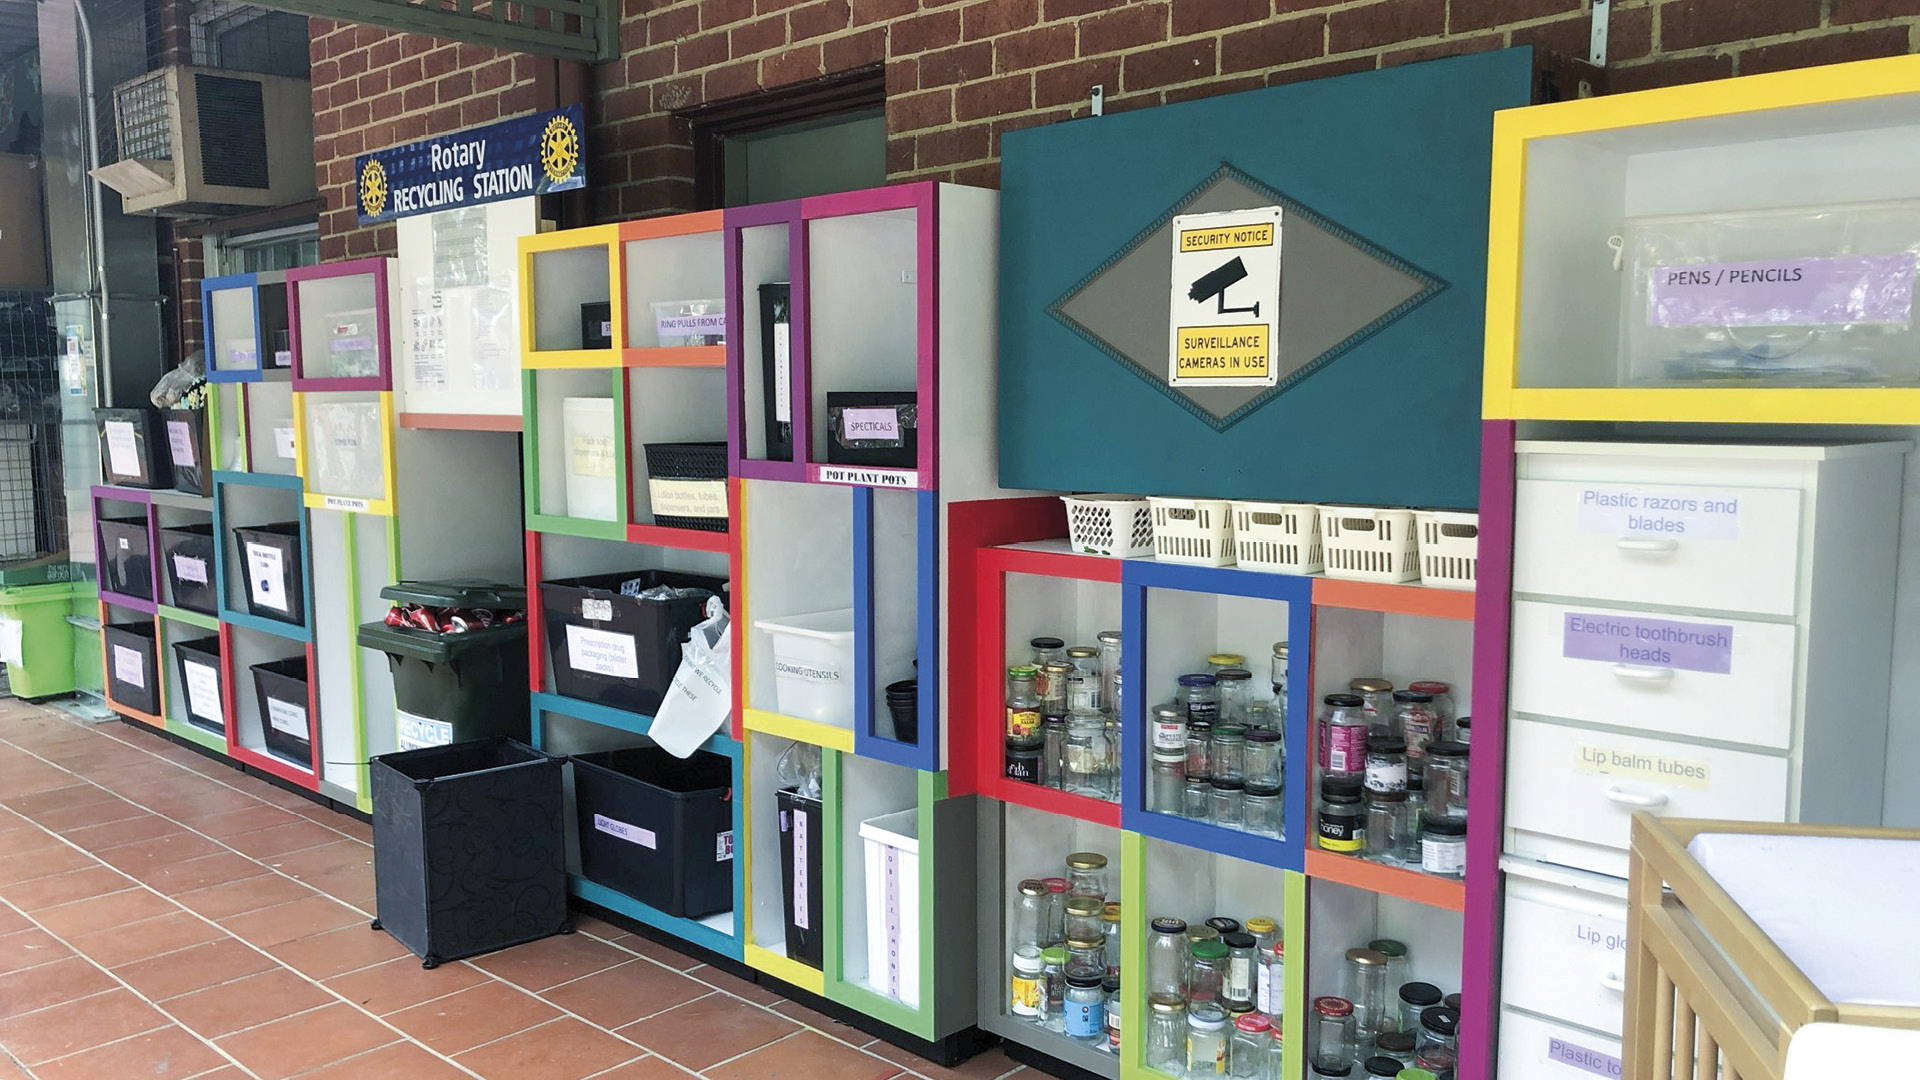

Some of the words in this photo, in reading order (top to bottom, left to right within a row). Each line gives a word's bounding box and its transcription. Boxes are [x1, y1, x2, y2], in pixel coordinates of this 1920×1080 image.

[431, 140, 486, 172] Rotary
[394, 177, 464, 213] RECYCLING
[473, 164, 533, 199] STATION
[1186, 233, 1231, 247] SECURITY
[1234, 230, 1268, 243] NOTICE
[1668, 270, 1711, 286] PENS
[1715, 270, 1725, 286] /
[1729, 268, 1802, 284] PENCILS
[661, 320, 676, 328] RING
[678, 319, 696, 328] PULLS
[698, 318, 717, 326] FROM
[1184, 336, 1260, 349] SURVEILLANCE
[1179, 357, 1226, 369] CAMERAS
[1230, 356, 1240, 368] IN
[1244, 356, 1265, 368] USE
[850, 421, 893, 432] SPECTICALS
[826, 470, 845, 482] POT
[847, 472, 879, 484] PLANT
[881, 474, 907, 486] POTS
[1583, 490, 1638, 508] Plastic
[1643, 497, 1697, 512] razors
[1703, 498, 1737, 514] and
[1628, 515, 1685, 533] blades
[1570, 617, 1630, 637] Electric
[1635, 624, 1728, 648] toothbrush
[581, 636, 611, 649] Prescription
[1619, 643, 1671, 664] heads
[775, 661, 803, 676] COOKING
[682, 686, 698, 701] THESE
[703, 675, 723, 695] RECYCLE
[1582, 746, 1607, 764] Lip
[1611, 751, 1652, 771] balm
[1657, 759, 1705, 779] tubes
[1577, 924, 1602, 945] Lip
[1550, 1040, 1602, 1070] Plastic
